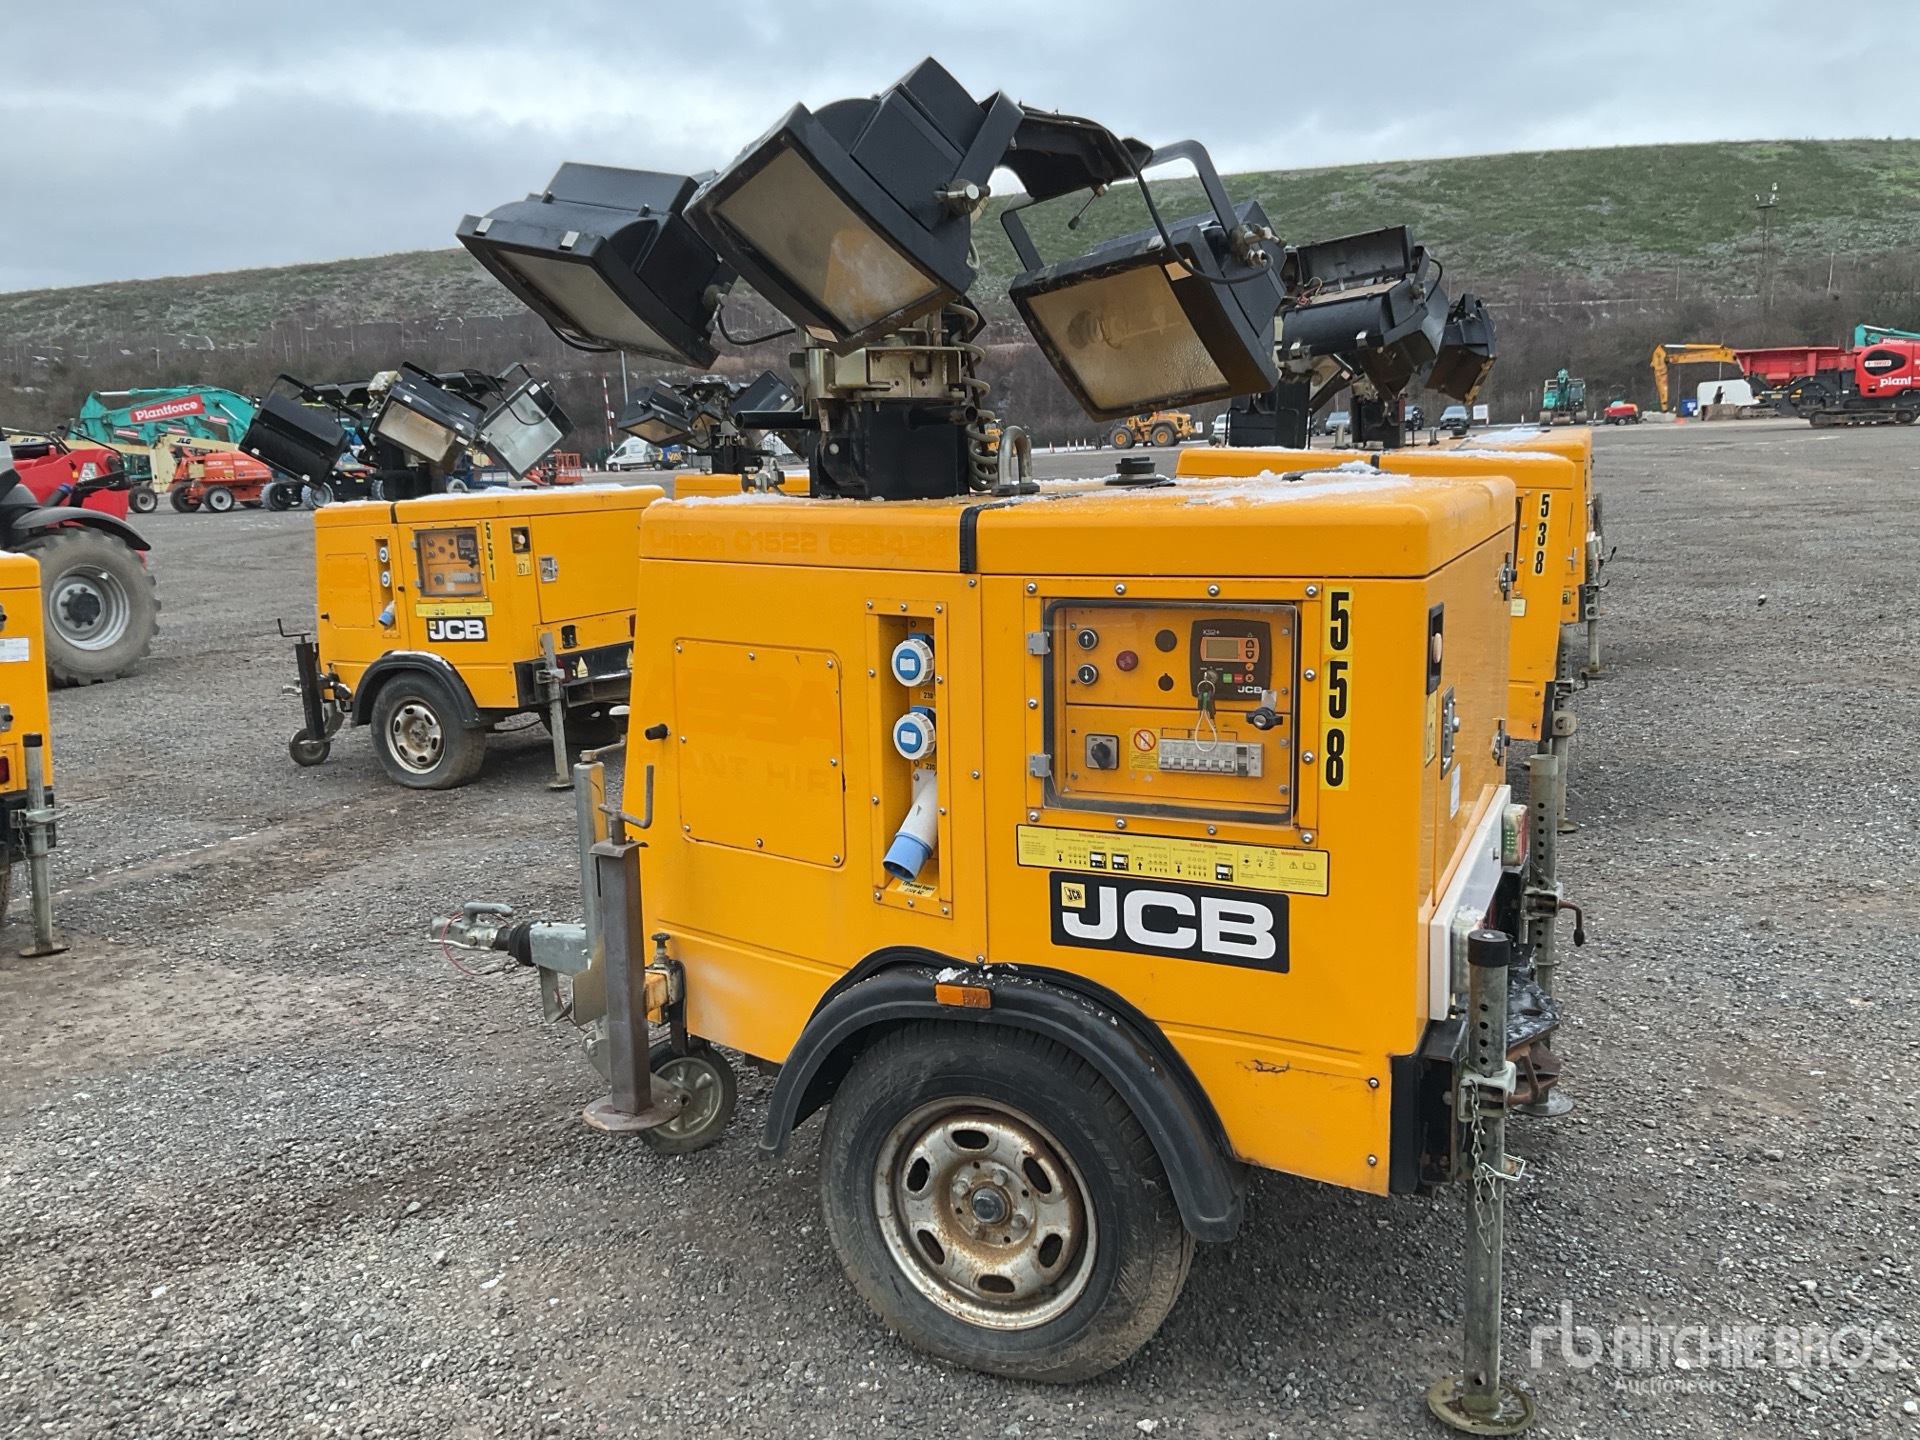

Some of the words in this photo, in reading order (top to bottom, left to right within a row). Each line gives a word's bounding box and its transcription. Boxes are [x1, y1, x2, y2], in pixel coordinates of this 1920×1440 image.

[134, 400, 199, 421] Plantforce
[176, 437, 192, 445] JLG
[429, 620, 485, 640] JCB
[1237, 686, 1263, 694] JCB
[1325, 591, 1350, 787] 558
[1067, 888, 1082, 900] JCB
[1062, 886, 1277, 960] JCB
